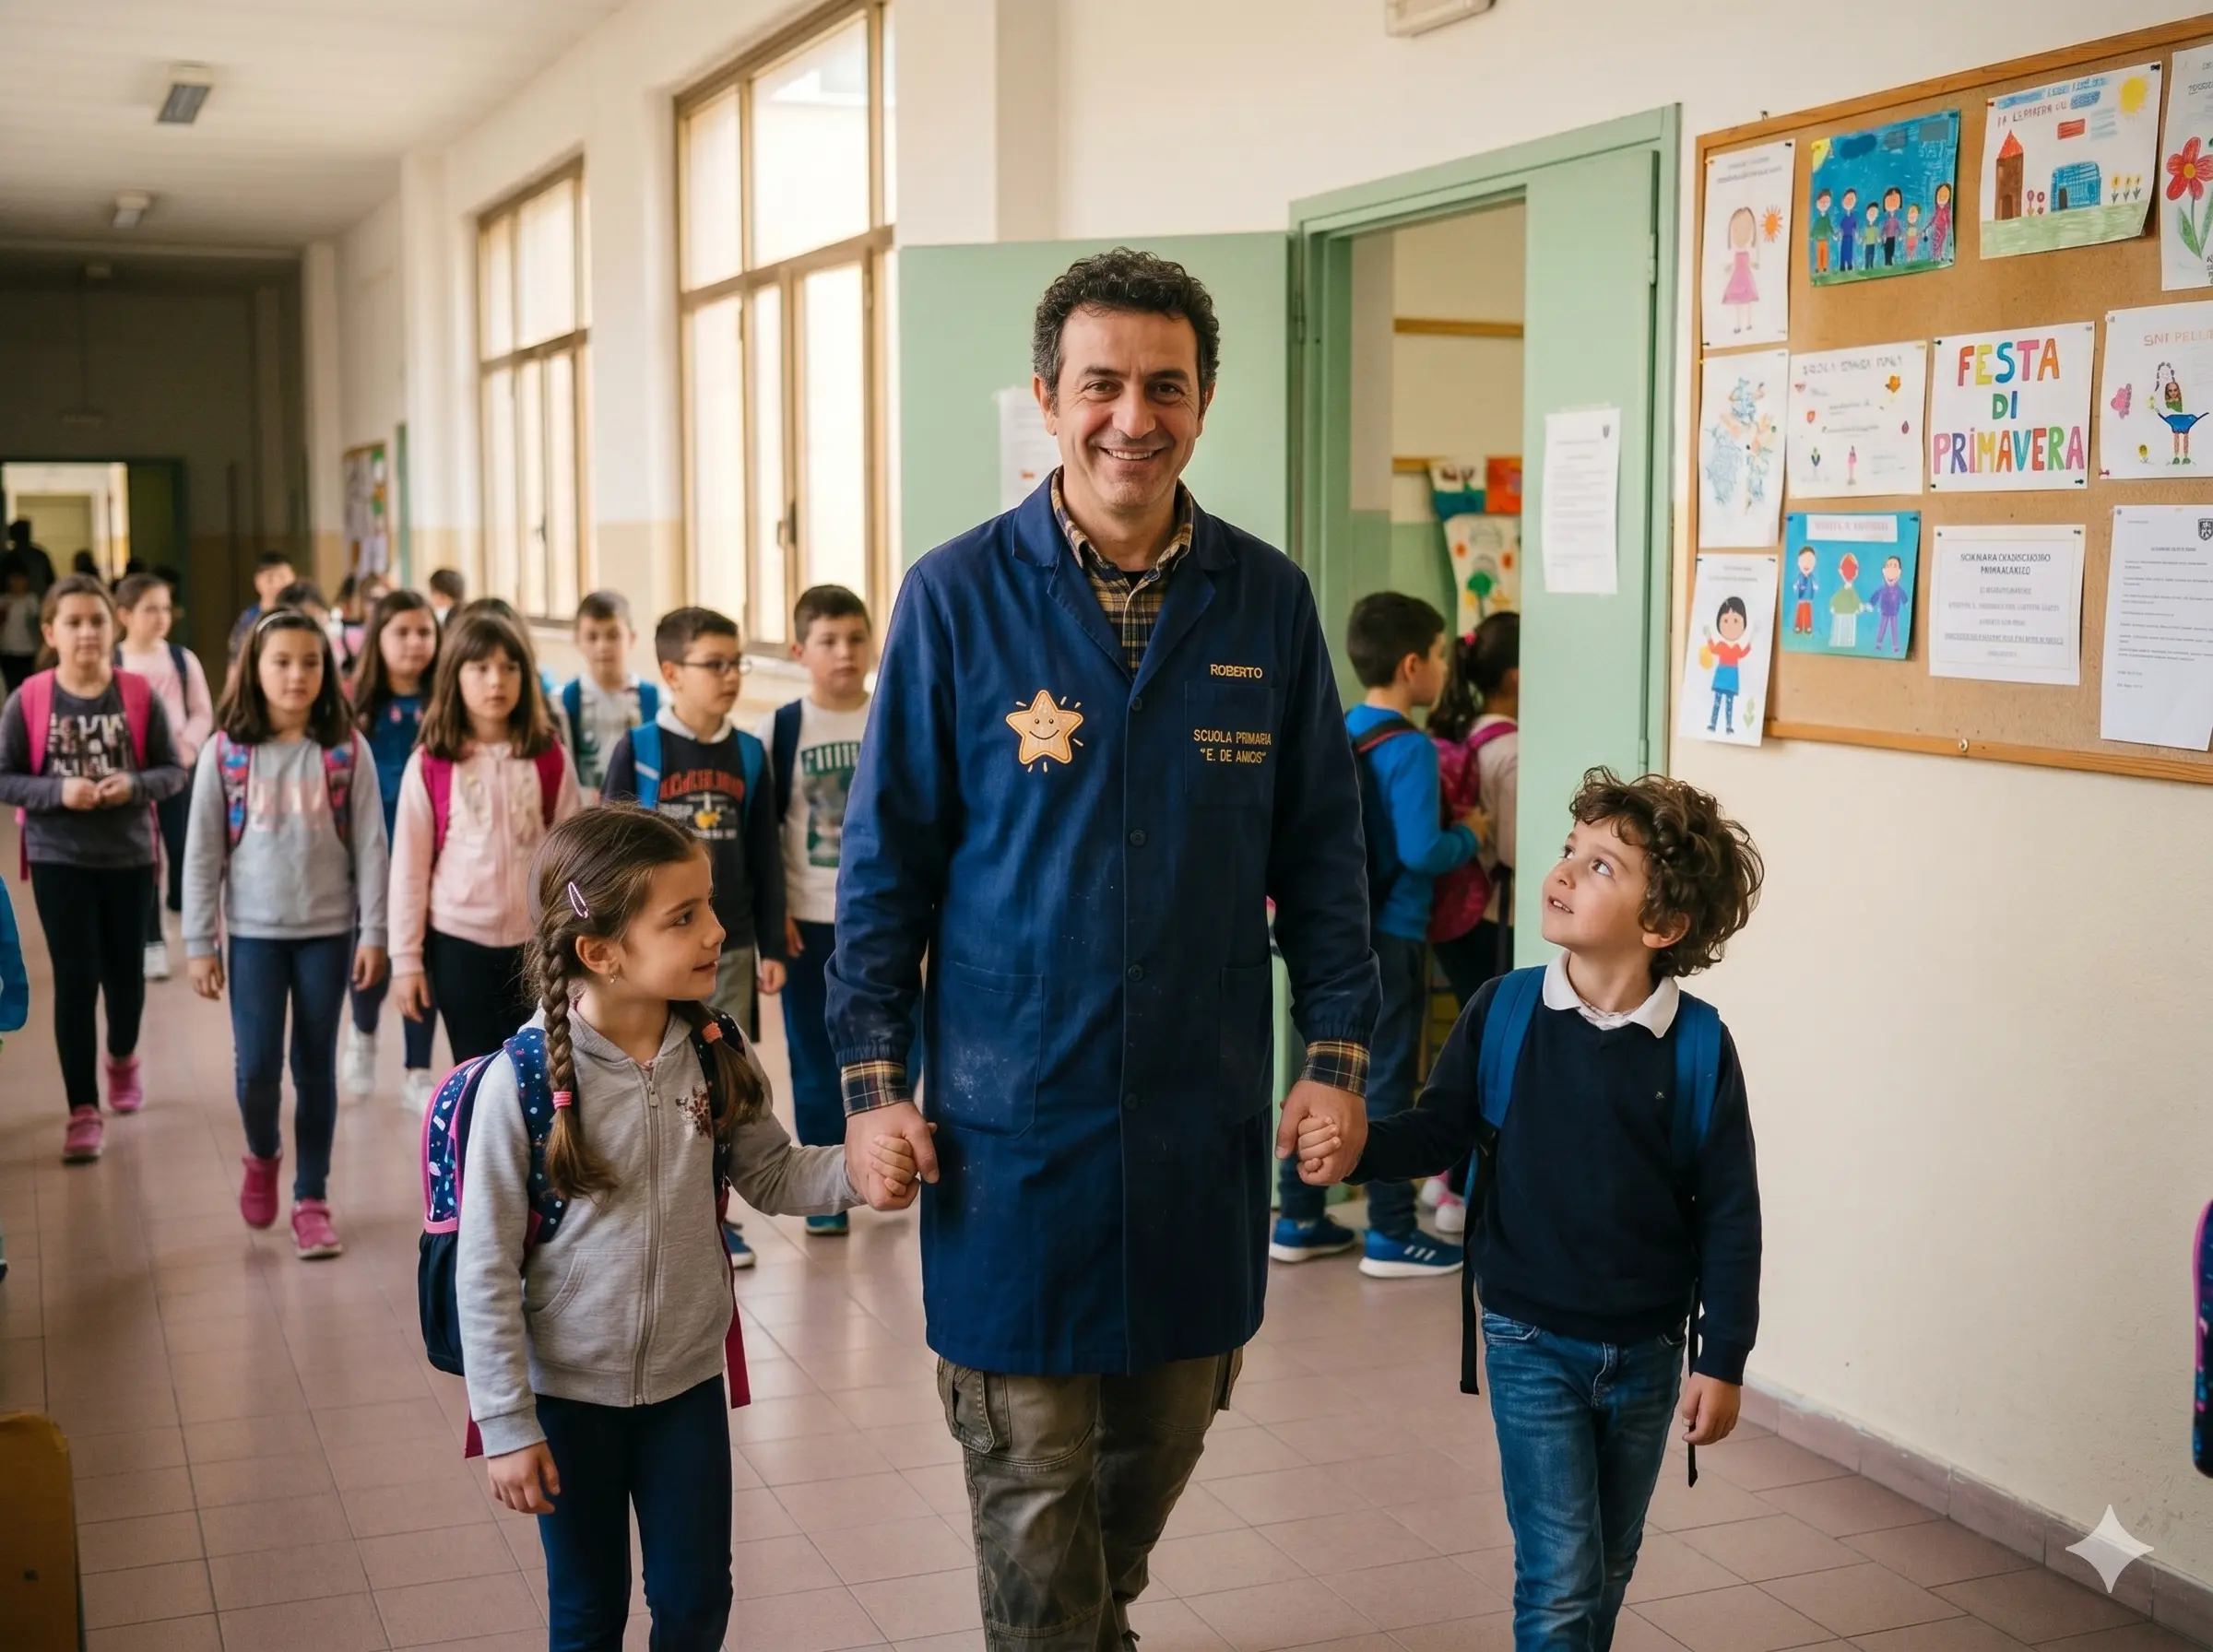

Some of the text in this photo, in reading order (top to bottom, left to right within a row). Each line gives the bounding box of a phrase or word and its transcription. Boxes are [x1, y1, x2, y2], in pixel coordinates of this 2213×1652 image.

[1958, 338, 2060, 386] FESTA
[1993, 390, 2018, 419] DI
[1210, 664, 1263, 678] ROBERTO
[1193, 729, 1232, 744] SCUOLA
[1220, 749, 1233, 762] DE
